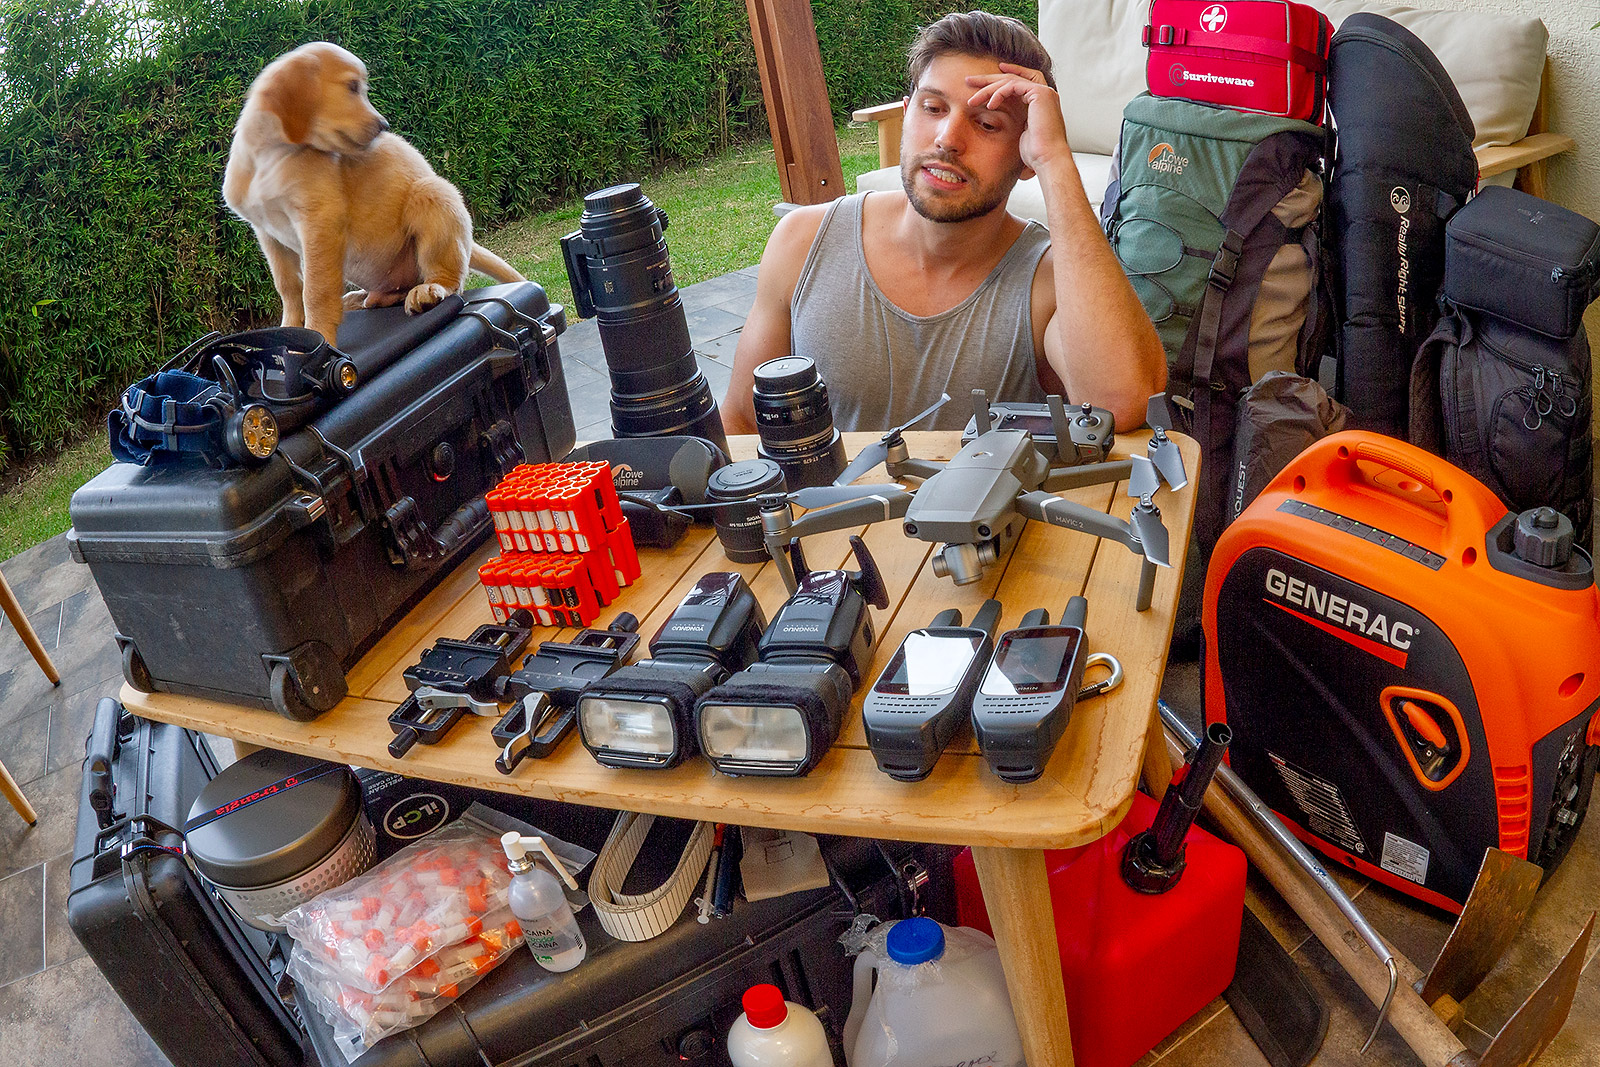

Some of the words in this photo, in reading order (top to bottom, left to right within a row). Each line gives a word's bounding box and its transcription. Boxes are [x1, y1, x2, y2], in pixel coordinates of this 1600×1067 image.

[1183, 71, 1254, 87] Surviveware
[1151, 160, 1183, 175] alpine
[1162, 150, 1189, 167] Lowe
[1397, 215, 1410, 256] Really
[1397, 257, 1409, 293] Right
[1397, 294, 1406, 334] Stuff
[613, 477, 639, 488] alpine
[620, 470, 644, 479] Lowe
[1055, 515, 1078, 527] MAVIC
[1265, 568, 1413, 650] GENERAC
[368, 776, 403, 795] PELICAN
[215, 785, 279, 815] trangia
[392, 801, 439, 830] iLCP
